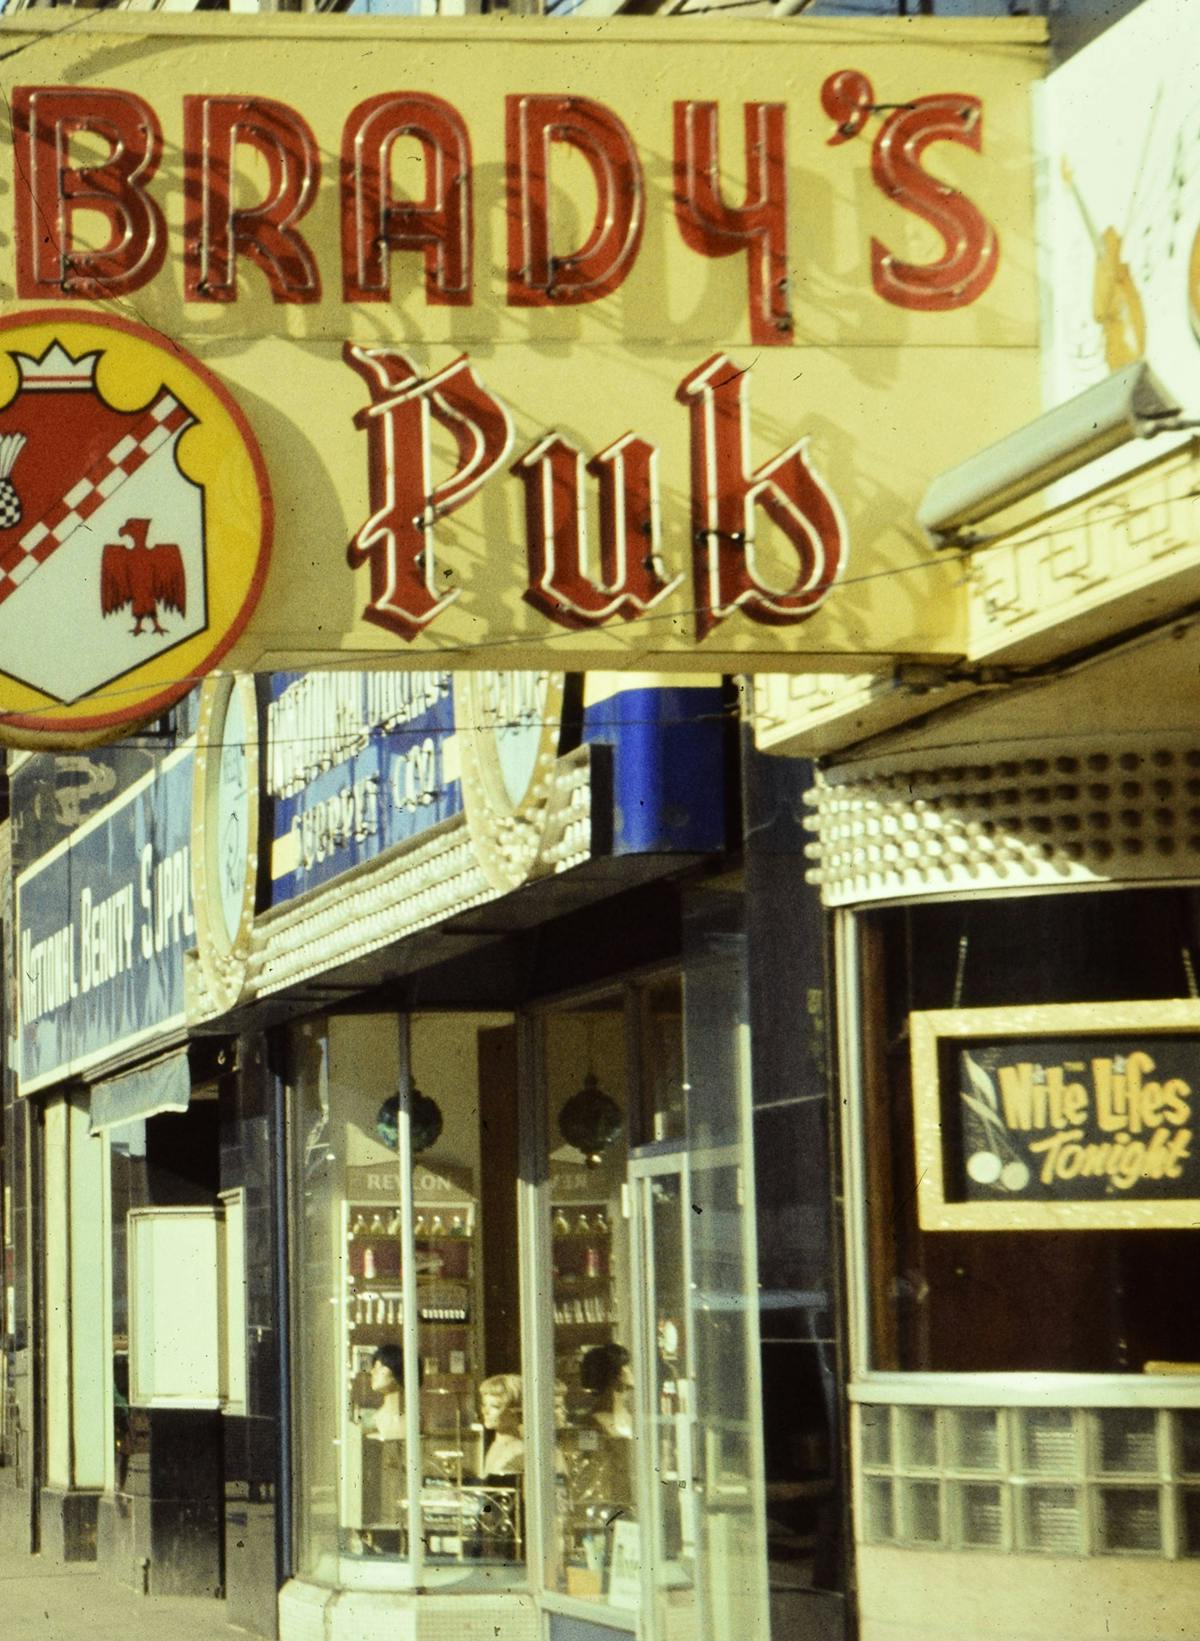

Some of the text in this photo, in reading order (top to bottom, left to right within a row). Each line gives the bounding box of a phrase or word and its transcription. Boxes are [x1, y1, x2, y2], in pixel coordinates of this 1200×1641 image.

[11, 70, 1000, 346] BRADY'S
[344, 341, 849, 642] Pub
[1029, 1128, 1192, 1189] Tonight
